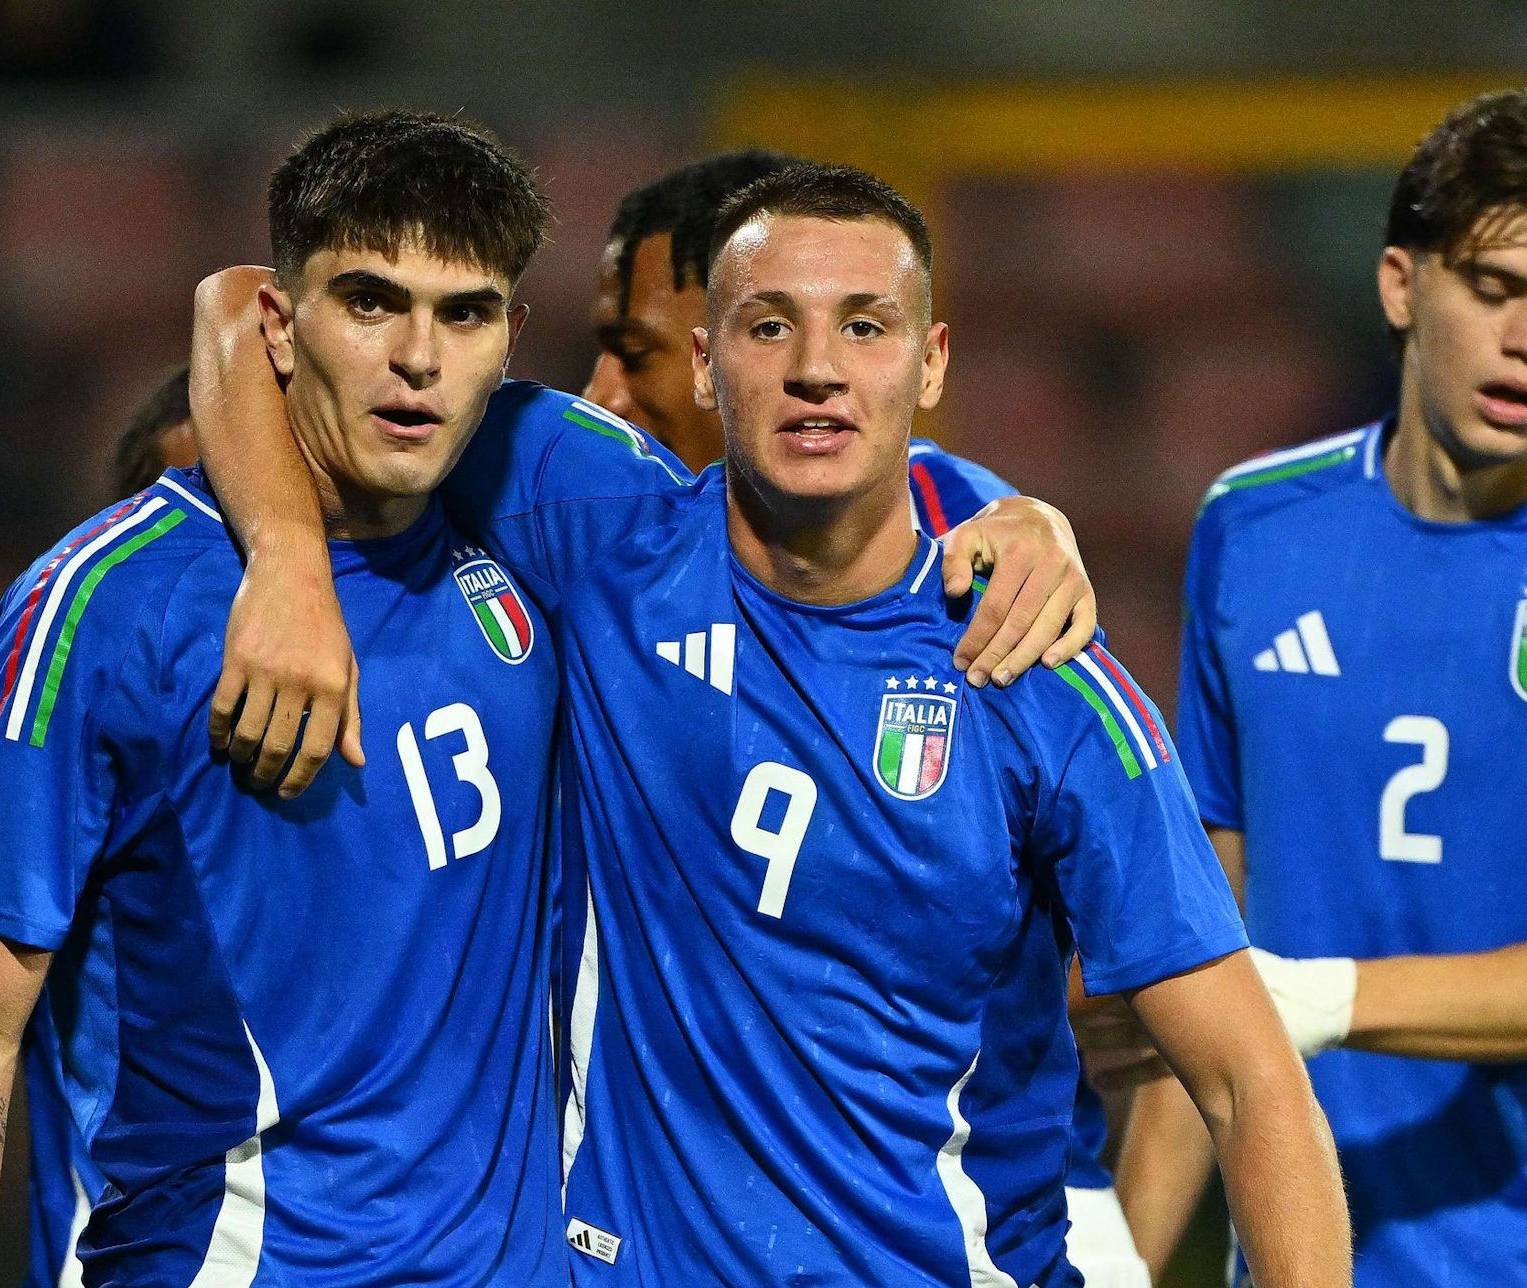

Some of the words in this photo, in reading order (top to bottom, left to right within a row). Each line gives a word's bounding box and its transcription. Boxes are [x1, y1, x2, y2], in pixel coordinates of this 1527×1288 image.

[458, 566, 505, 595] ITALIA
[886, 701, 948, 726] ITALIA
[907, 724, 926, 733] FIGC
[397, 702, 502, 871] 13
[1379, 715, 1450, 864] 2
[730, 761, 818, 919] 9
